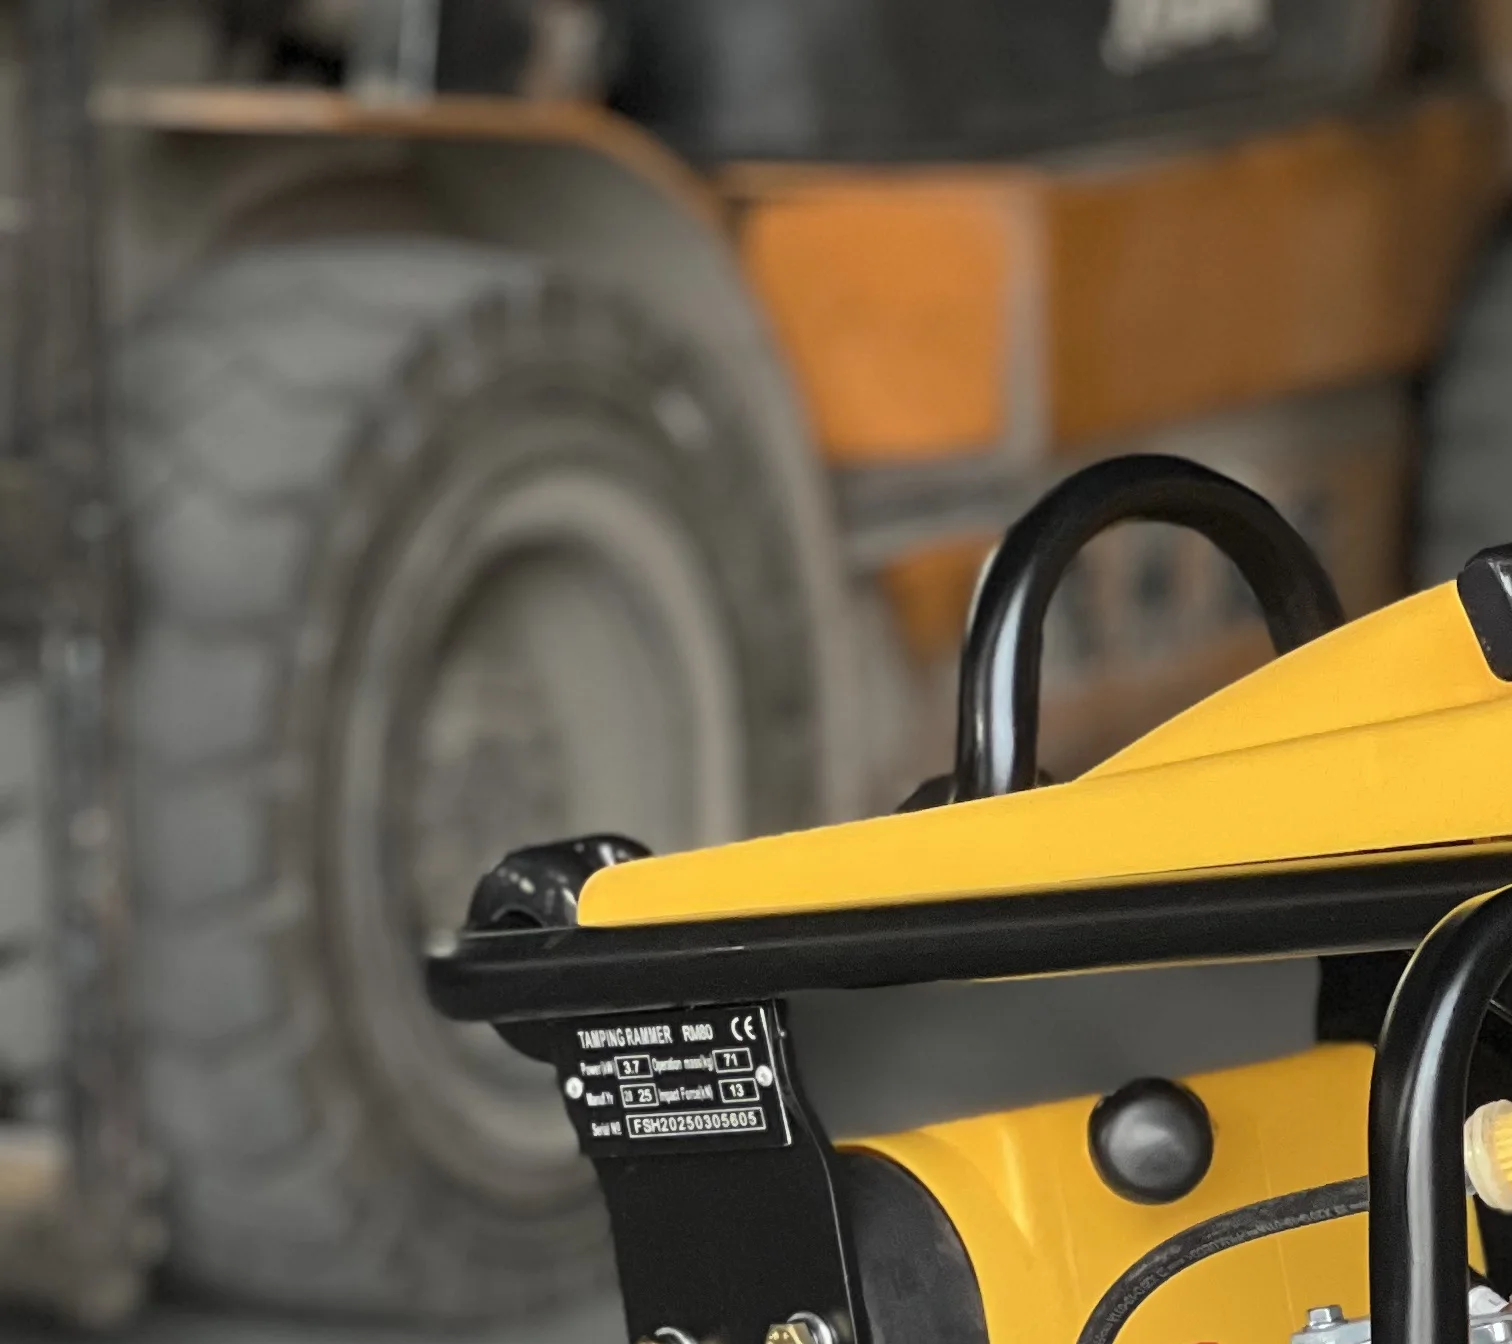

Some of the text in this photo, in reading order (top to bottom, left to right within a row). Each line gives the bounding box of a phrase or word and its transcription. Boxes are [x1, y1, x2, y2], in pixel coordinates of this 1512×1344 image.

[577, 1028, 625, 1049] TAMPING
[625, 1025, 673, 1046] RAMMER
[623, 1060, 640, 1075] 3.7
[723, 1053, 739, 1067] 71
[637, 1088, 653, 1103] 25
[729, 1083, 745, 1098] 13
